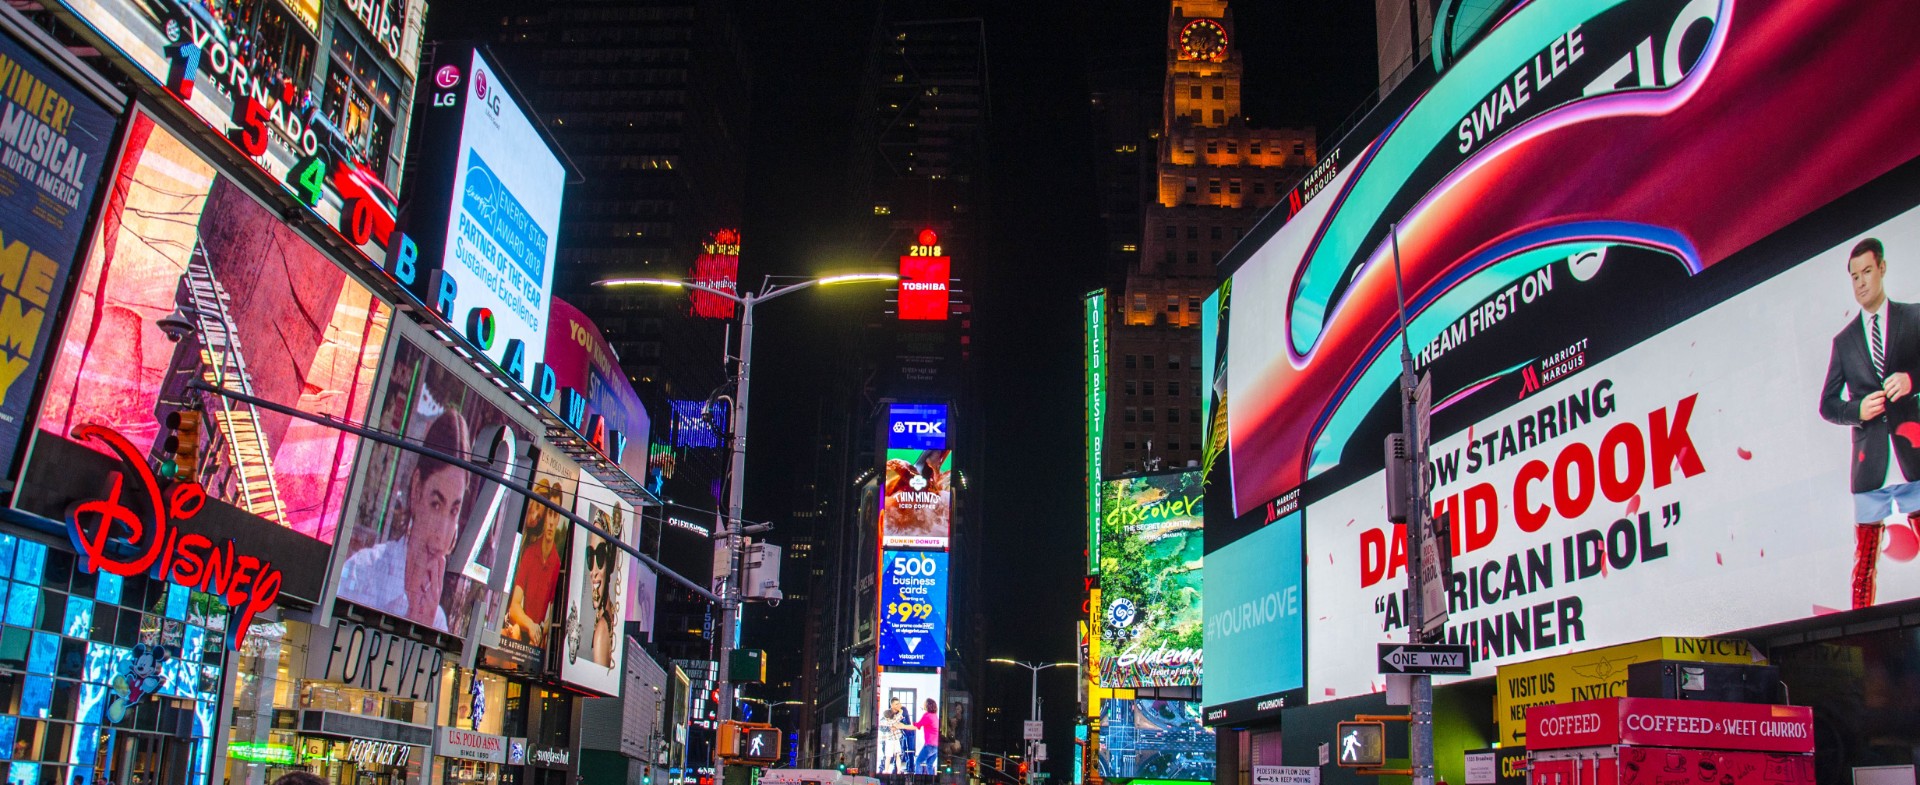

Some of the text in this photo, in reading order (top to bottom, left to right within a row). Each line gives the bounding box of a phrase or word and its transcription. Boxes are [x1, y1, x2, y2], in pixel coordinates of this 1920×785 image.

[190, 16, 318, 156] VORNADO
[1458, 66, 1530, 154] SWAE
[1535, 23, 1584, 92] LEE
[433, 93, 456, 107] LG
[487, 86, 501, 117] LG
[208, 75, 297, 158] REA RUST
[0, 102, 87, 191] MUSICAL
[2, 147, 37, 182] NORTH
[36, 171, 81, 210] AMERICA
[1304, 148, 1341, 190] MARRIOTT
[1304, 167, 1337, 204] MARQUIS
[499, 190, 547, 255] ENERGY STAR
[168, 42, 627, 465] 1540 BROADWAY
[458, 212, 541, 310] PARTNER OF THE YEAR
[496, 219, 541, 276] AWARD 2018
[910, 245, 942, 257] 2018
[455, 237, 538, 332] Sustained Excellence
[902, 282, 946, 291] TOSHIBA
[1412, 264, 1553, 371] TREAM FIRST ON
[569, 319, 592, 352] YOU
[1541, 337, 1588, 370] MARRIOTT
[1542, 355, 1584, 384] MARQUIS
[904, 421, 942, 434] TDK
[1467, 378, 1616, 474] STARRING
[894, 491, 939, 504] THIN MINTS
[1276, 488, 1300, 506] MARRIOTT
[1360, 482, 1499, 589] DAID
[1512, 392, 1706, 533] COOK
[1107, 483, 1204, 534] discover
[1276, 500, 1298, 517] MARQUIS
[1137, 522, 1160, 531] SECRET
[1161, 519, 1191, 529] COUNTRY
[893, 557, 936, 576] 500
[1374, 501, 1682, 633] “ARICAN IDOL”
[893, 575, 936, 586] business
[900, 584, 928, 595] cards
[1207, 585, 1298, 641] #YOURMOVE
[323, 617, 443, 703] FOREVER
[1117, 638, 1203, 667] Guatema
[1392, 653, 1458, 666] ONE WAY
[1674, 637, 1752, 657] INVICTA
[1150, 666, 1170, 679] Heart
[1169, 668, 1178, 678] of
[1179, 667, 1189, 676] the
[1508, 672, 1556, 699] VISIT US
[1257, 697, 1284, 711] #YOURMOVE
[1571, 679, 1629, 702] INVIC
[1510, 703, 1531, 721] NEX
[1540, 713, 1601, 737] COFFEED
[449, 730, 462, 745] U.S.
[462, 732, 482, 748] POLO
[1626, 714, 1807, 739] COFFEED & SWEET CHURROS
[348, 739, 411, 767] FOREVER 21
[460, 750, 476, 758] SINCE
[1502, 755, 1526, 778] COM
[1256, 768, 1311, 776] PEDESTRIAN FLOW ZONE
[1280, 776, 1311, 784] KEEP MOVING
